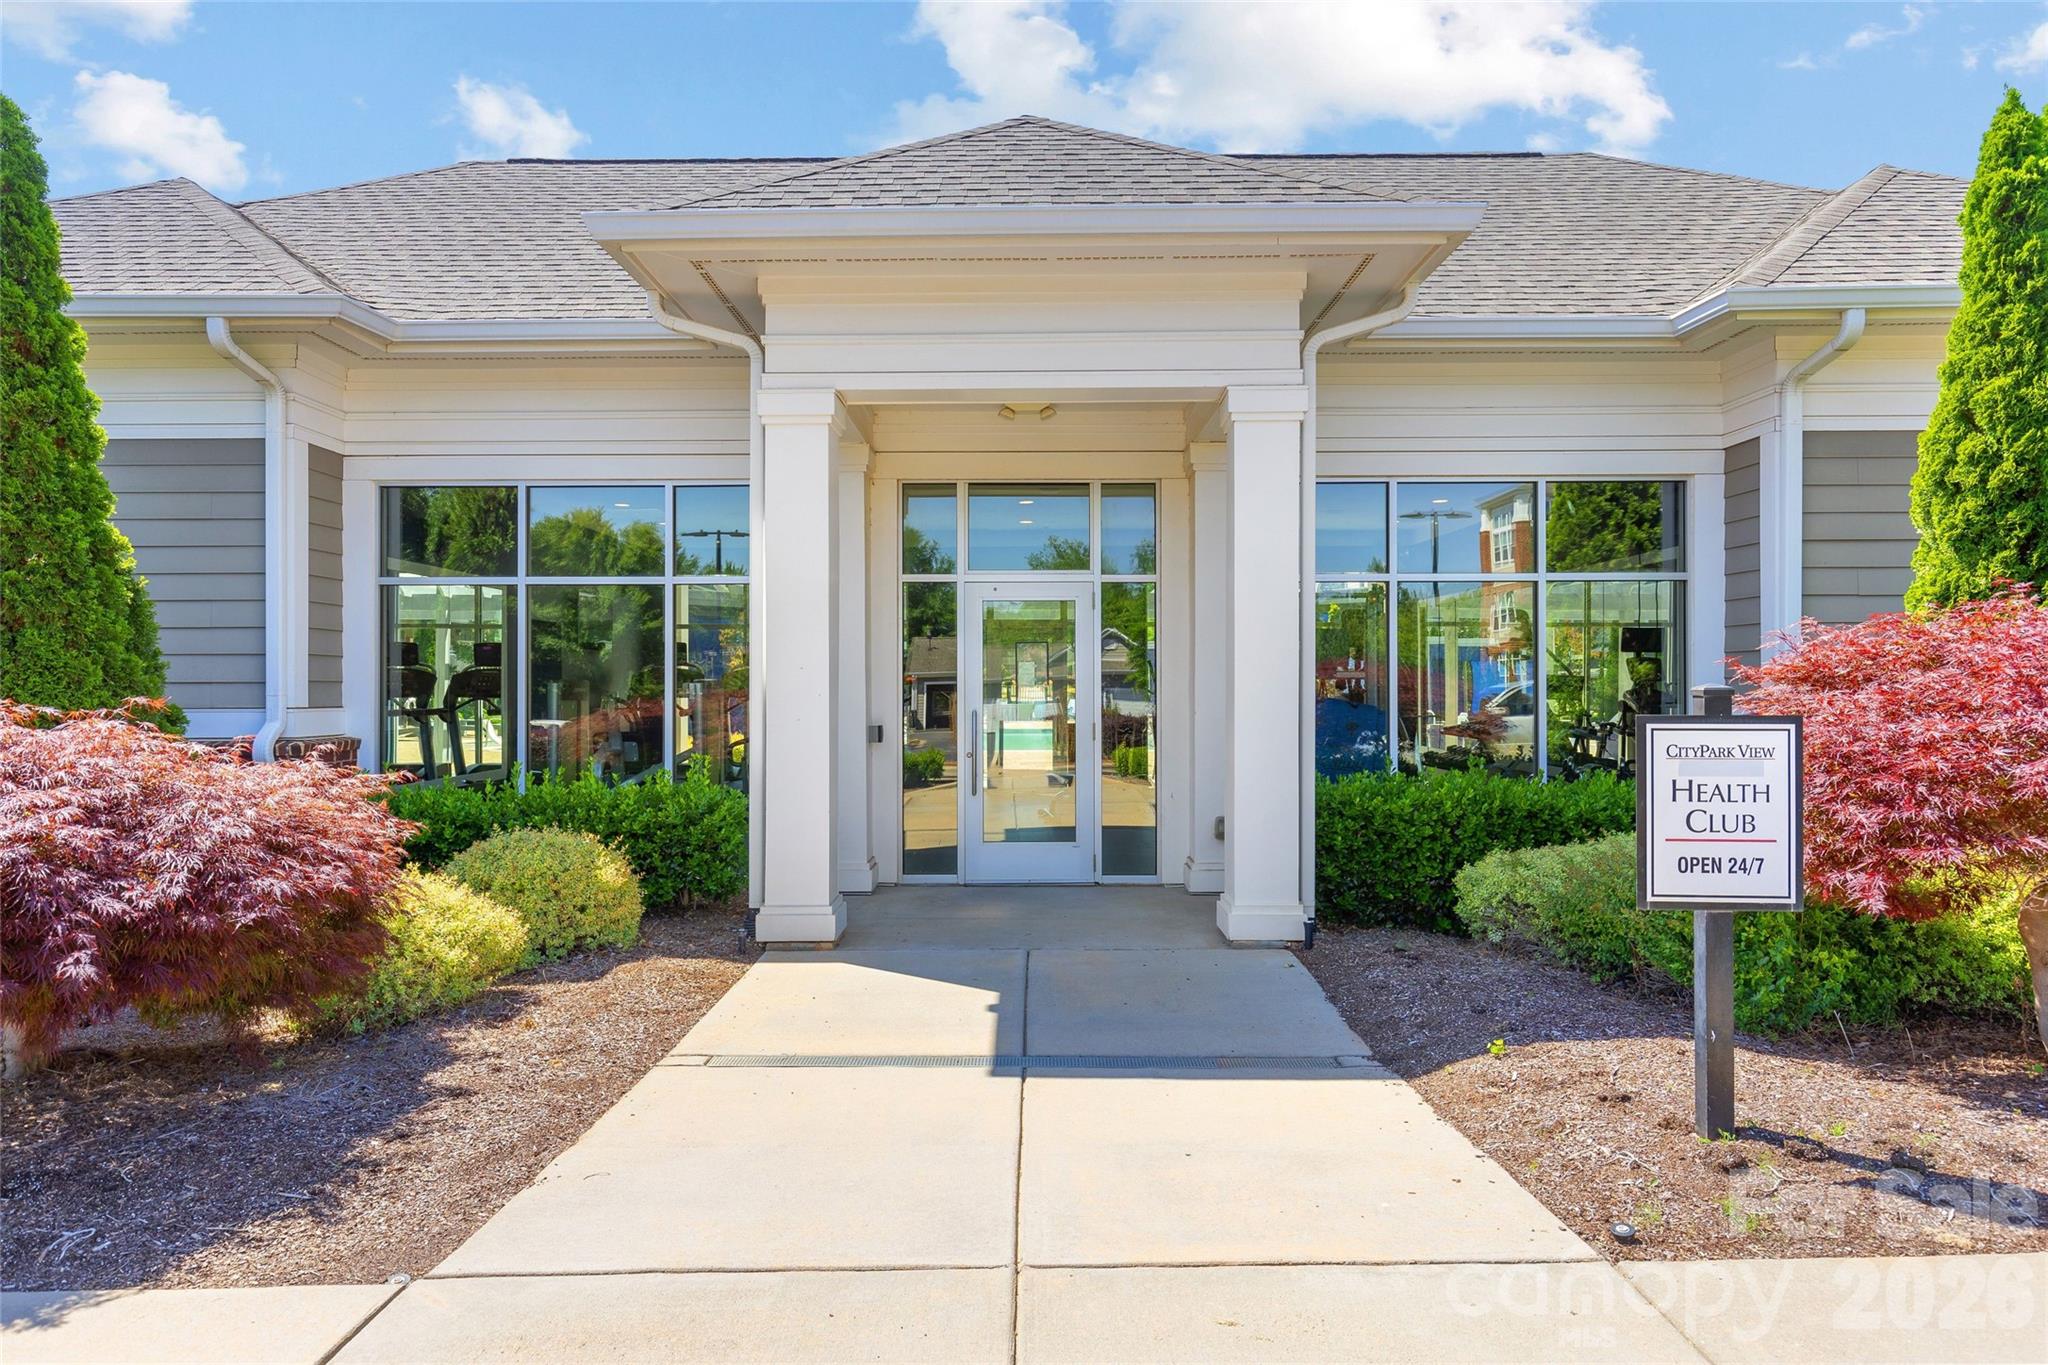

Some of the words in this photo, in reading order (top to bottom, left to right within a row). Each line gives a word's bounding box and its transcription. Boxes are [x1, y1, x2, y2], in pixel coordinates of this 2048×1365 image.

[1737, 744, 1776, 758] VIEW
[1671, 779, 1770, 803] HEALTH
[1685, 809, 1757, 833] CLUB
[1677, 856, 1722, 874] OPEN
[1728, 857, 1764, 876] 24/7
